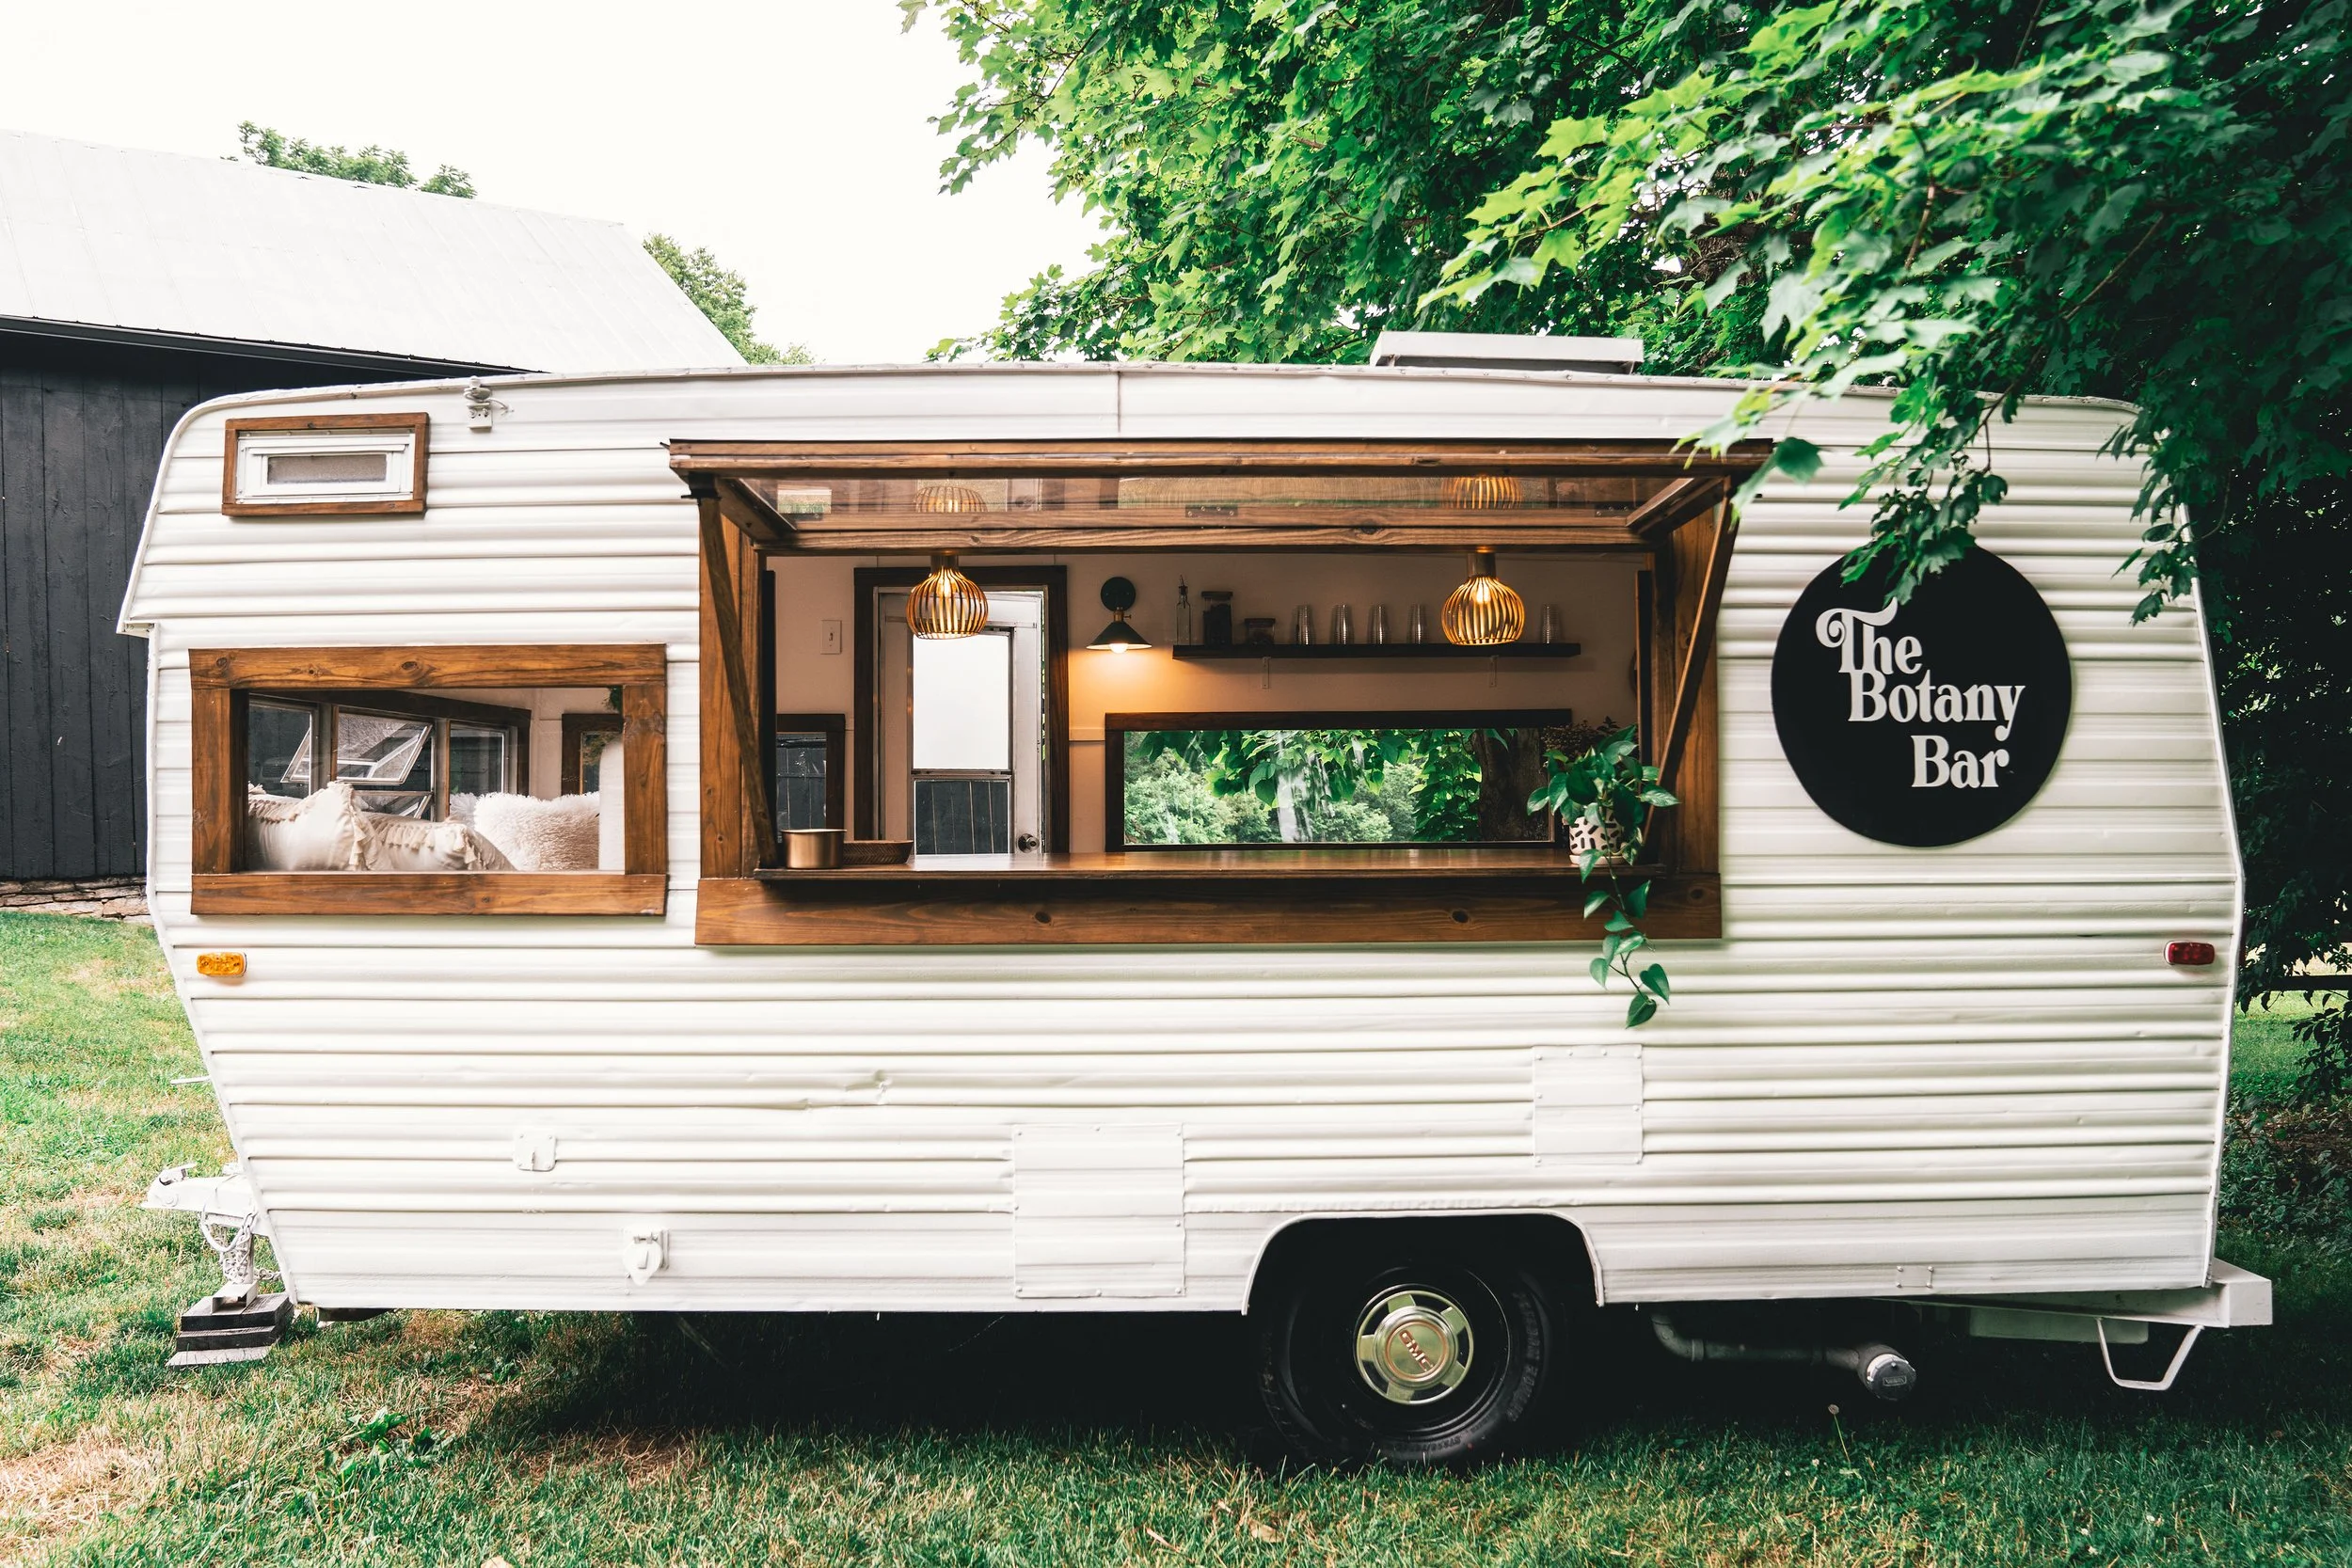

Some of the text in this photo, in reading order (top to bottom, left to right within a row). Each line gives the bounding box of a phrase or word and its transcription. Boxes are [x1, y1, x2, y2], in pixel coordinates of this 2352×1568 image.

[1815, 596, 1923, 674] The
[1847, 669, 2026, 742] Botany
[1911, 735, 2010, 789] Bar
[1399, 1329, 1434, 1372] GMC
